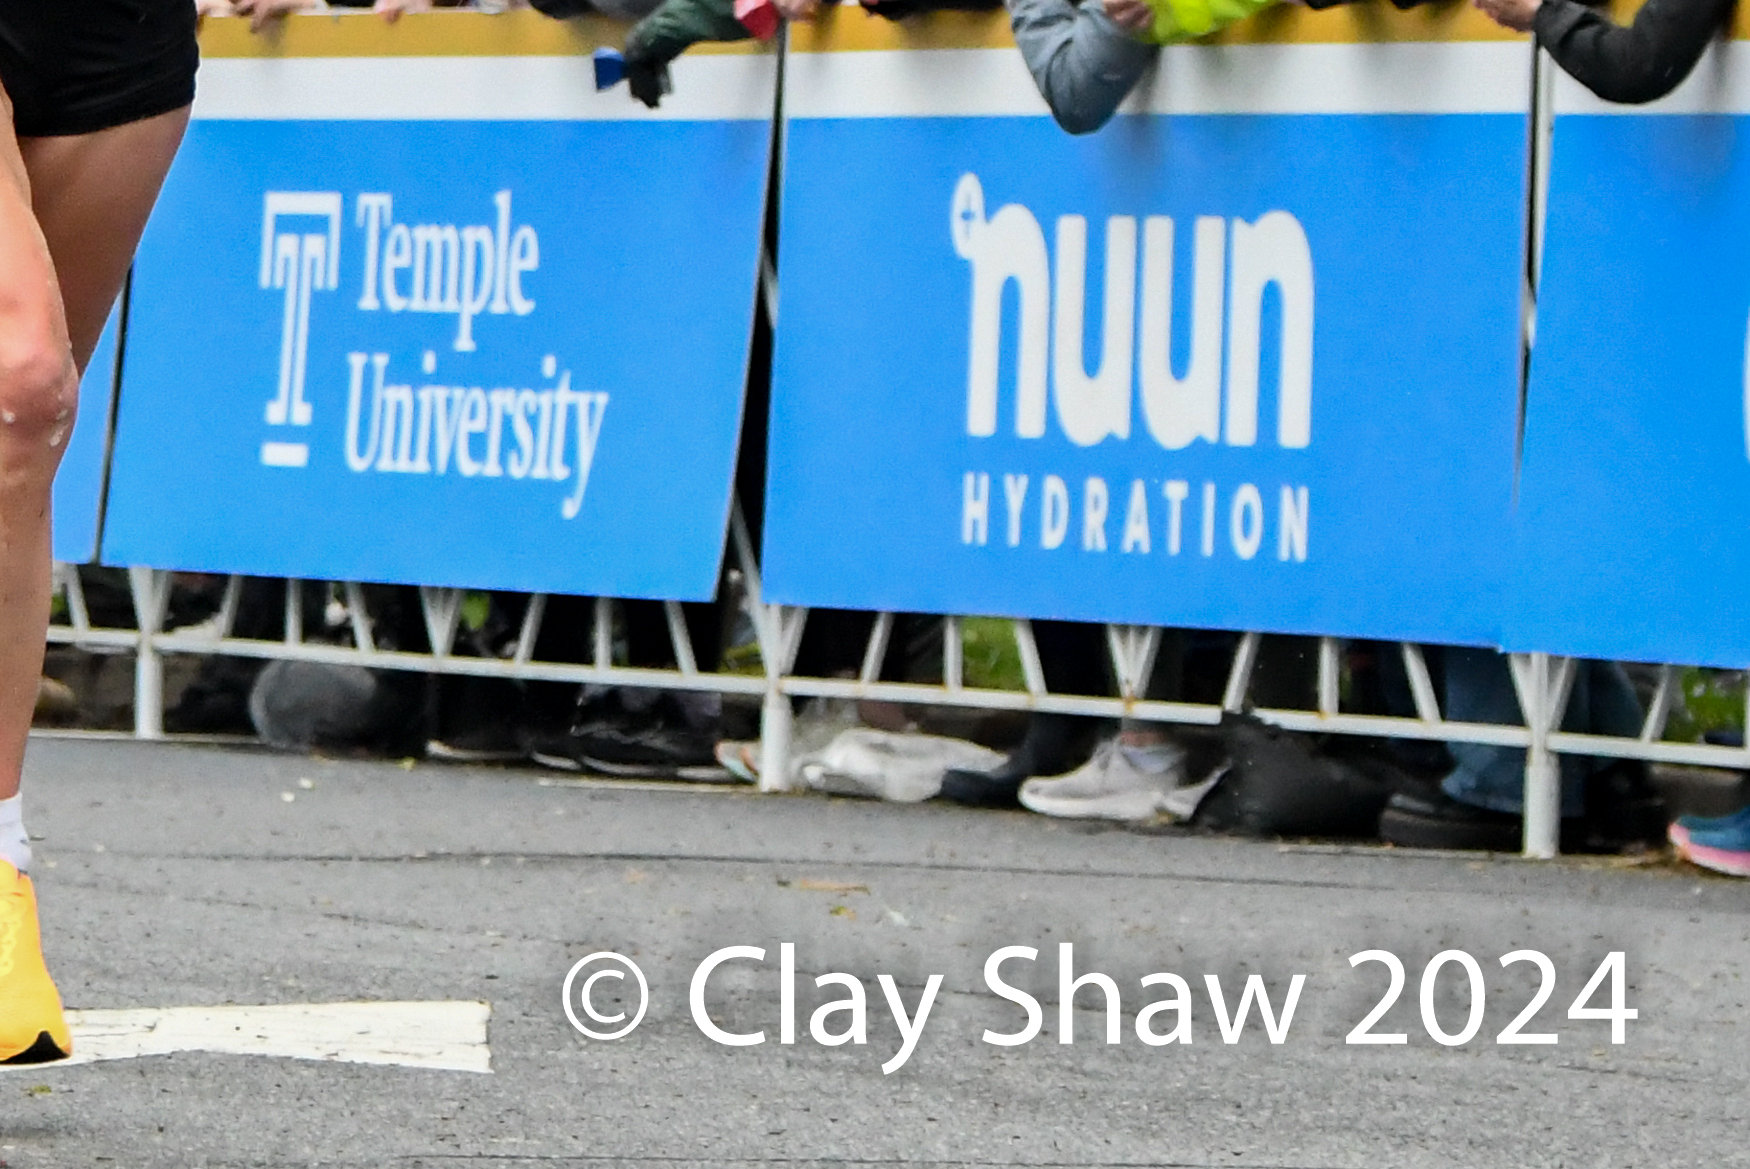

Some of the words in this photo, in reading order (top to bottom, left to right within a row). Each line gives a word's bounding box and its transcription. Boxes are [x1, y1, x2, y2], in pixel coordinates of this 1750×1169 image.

[355, 188, 541, 353] Temple
[948, 170, 1316, 452] nuun
[343, 345, 611, 521] University
[960, 470, 1310, 563] HYDRATION
